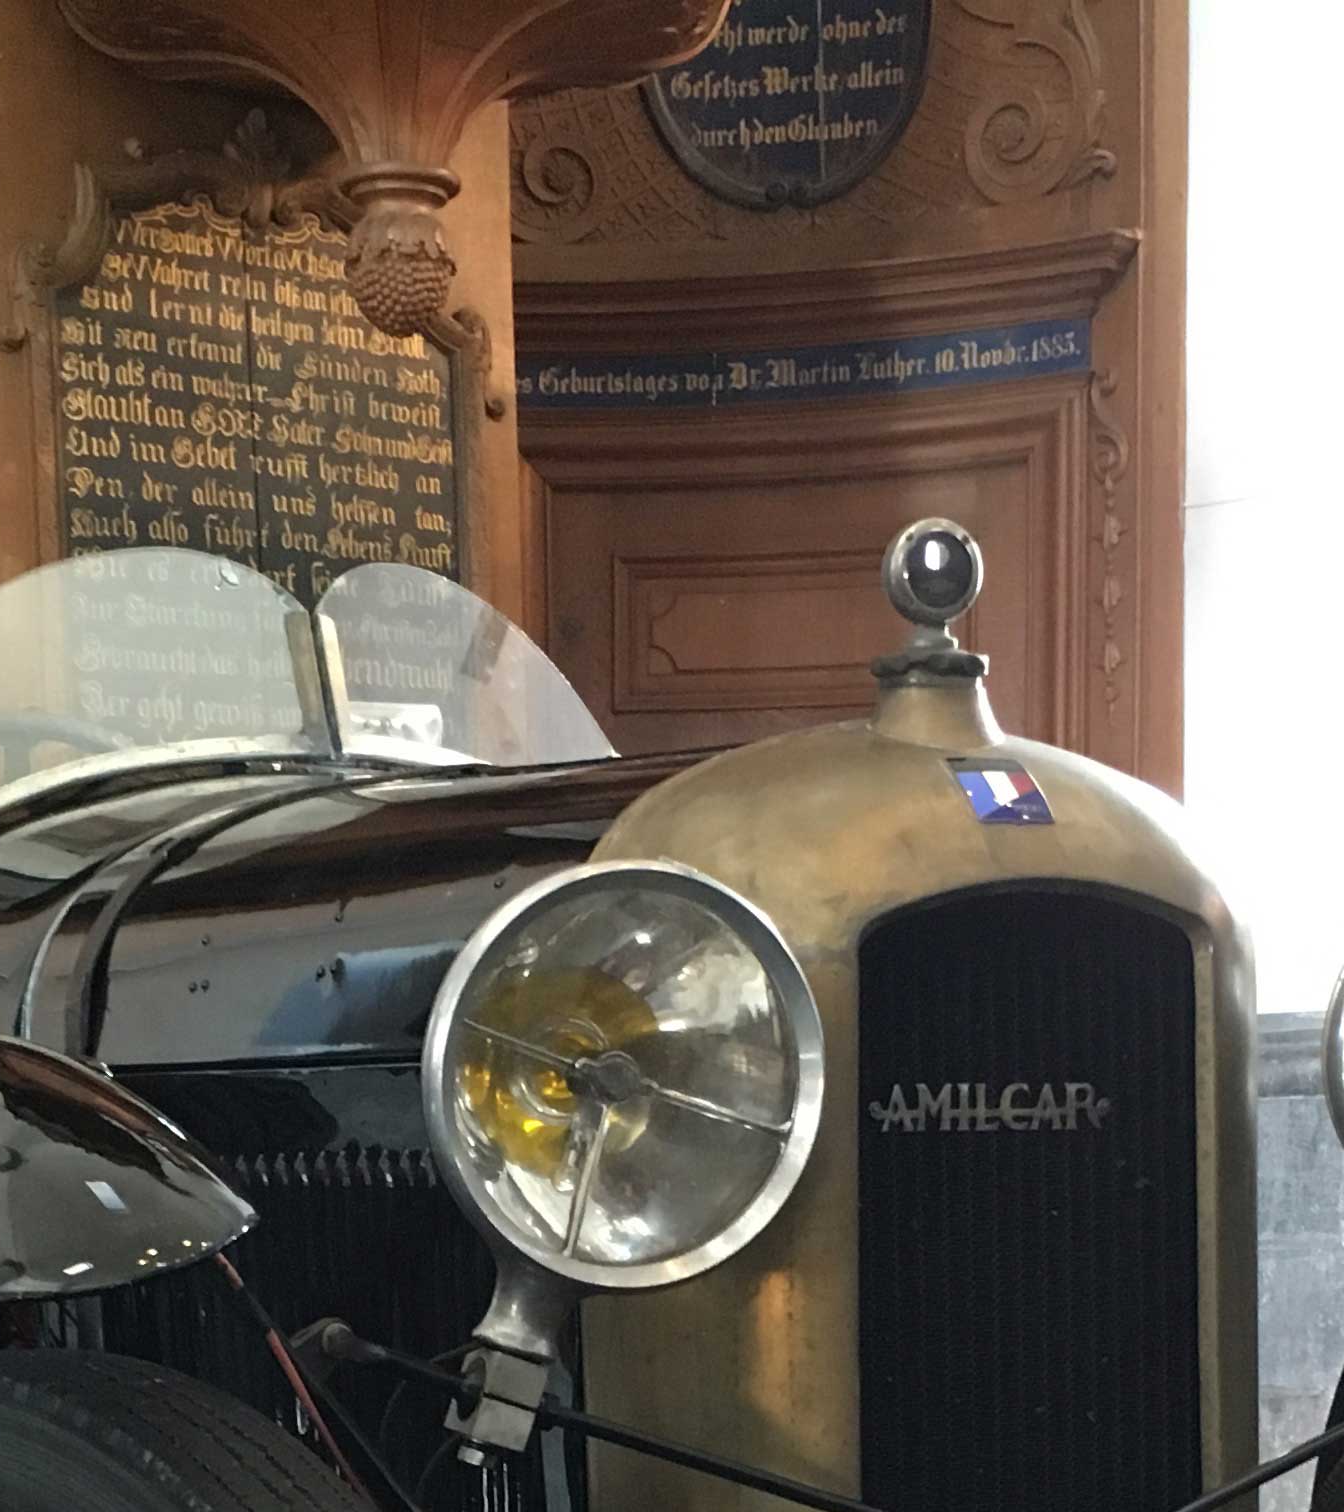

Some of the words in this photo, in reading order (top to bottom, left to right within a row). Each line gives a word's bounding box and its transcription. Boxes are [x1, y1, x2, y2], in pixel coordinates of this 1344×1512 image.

[847, 59, 905, 91] allein
[765, 358, 851, 388] Martin
[191, 477, 255, 510] allein
[880, 1081, 1105, 1134] AMILCAR
